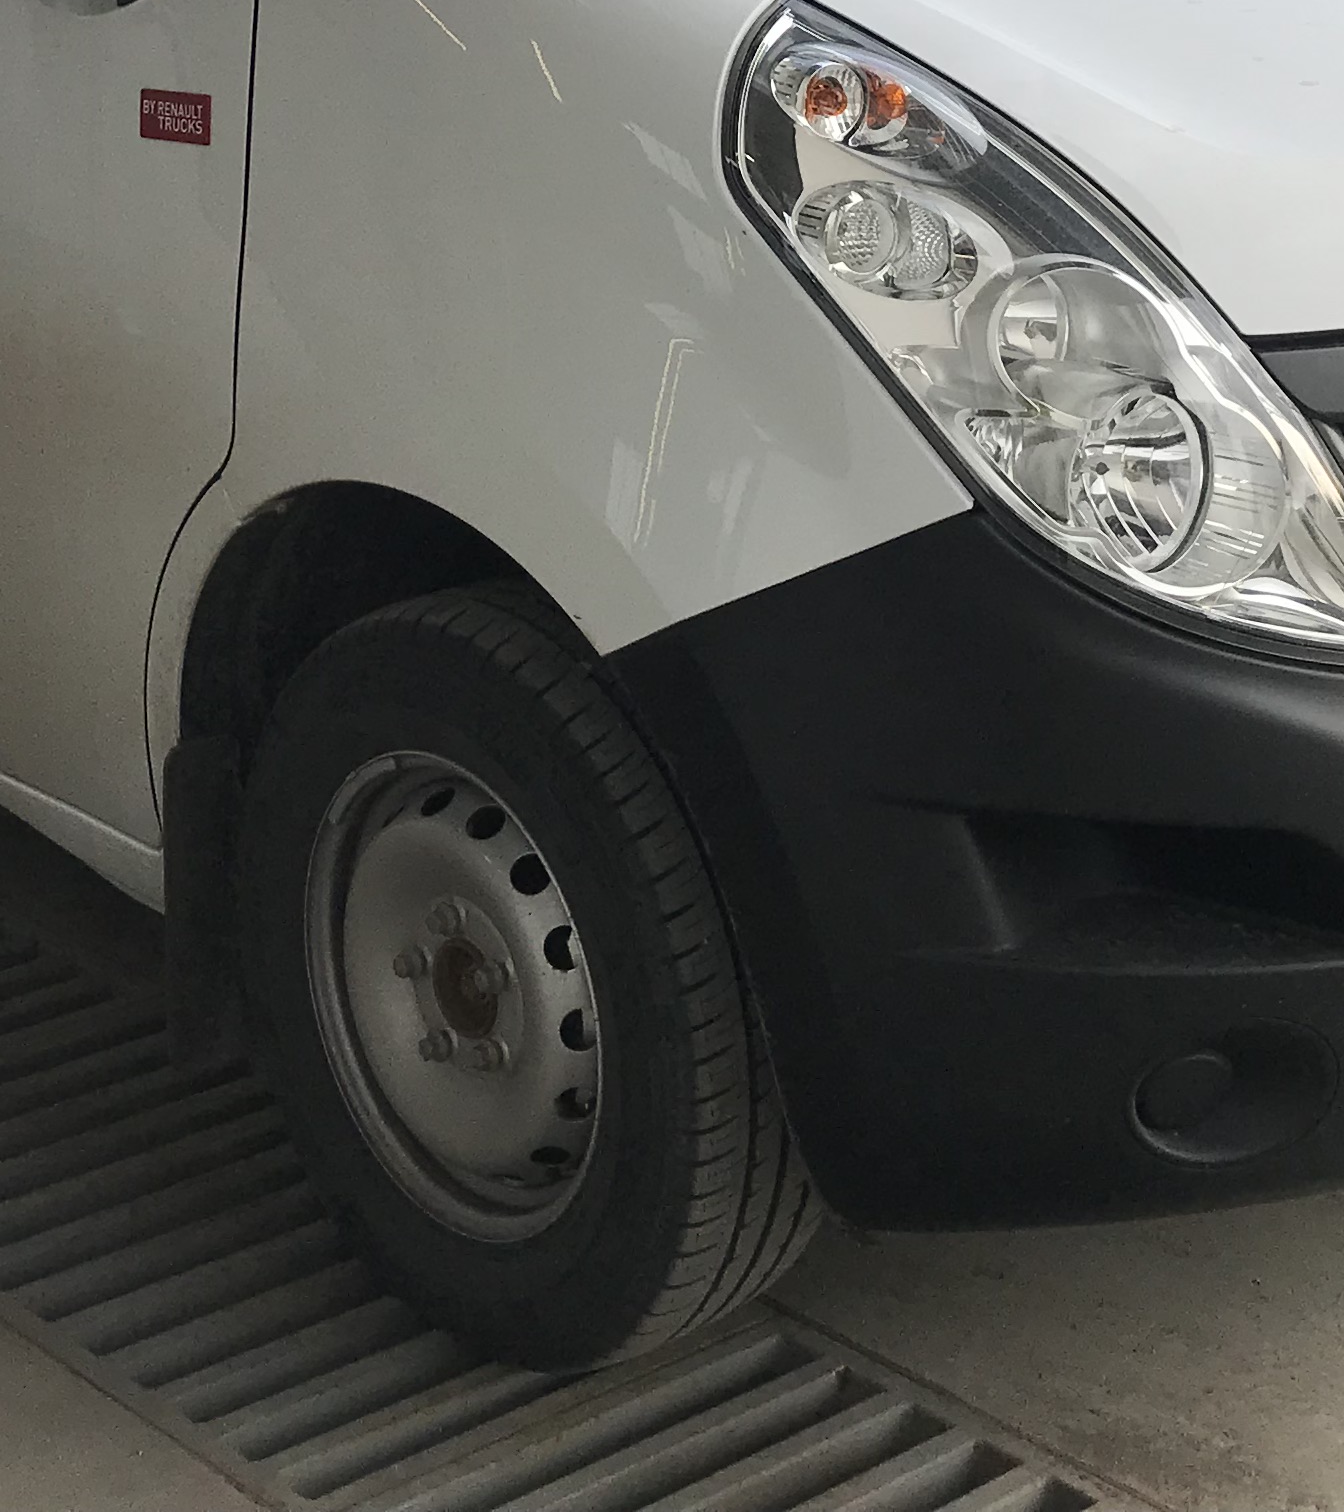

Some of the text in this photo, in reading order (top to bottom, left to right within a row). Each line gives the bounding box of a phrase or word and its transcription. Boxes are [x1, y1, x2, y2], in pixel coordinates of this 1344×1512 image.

[142, 99, 203, 120] BY RENAULT
[158, 115, 203, 135] TRUCKS
